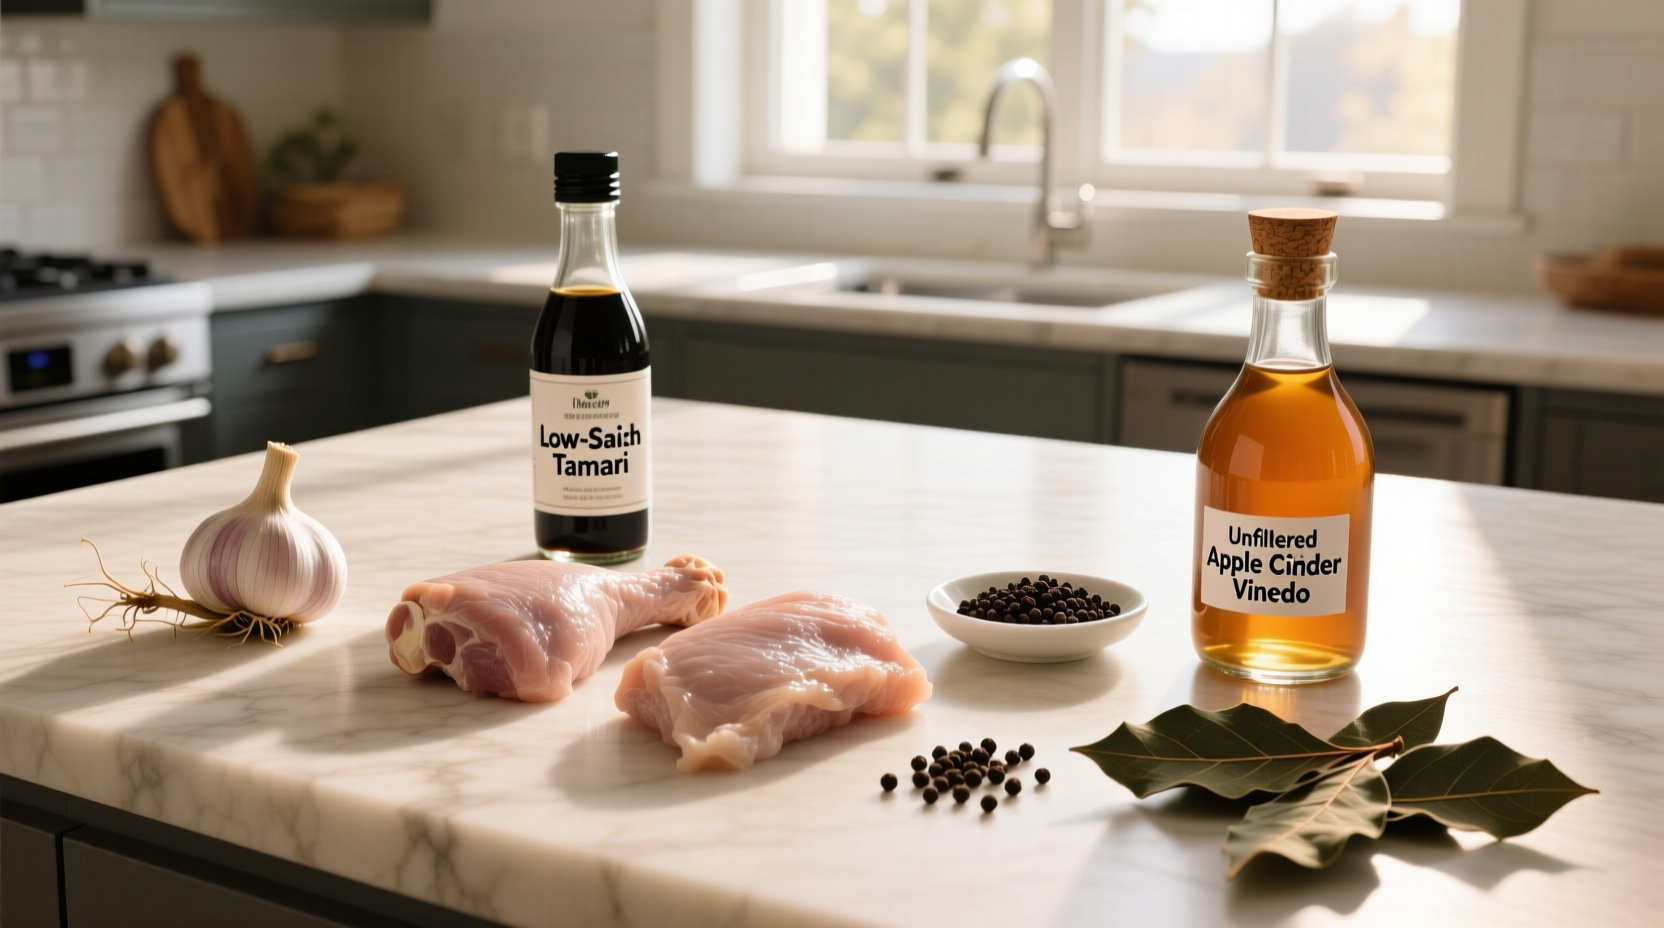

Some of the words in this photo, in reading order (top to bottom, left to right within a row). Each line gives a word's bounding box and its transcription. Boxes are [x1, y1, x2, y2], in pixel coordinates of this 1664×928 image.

[552, 450, 629, 476] Tamari
[1207, 545, 1263, 577] Apple
[1232, 578, 1311, 603] Vinedo
